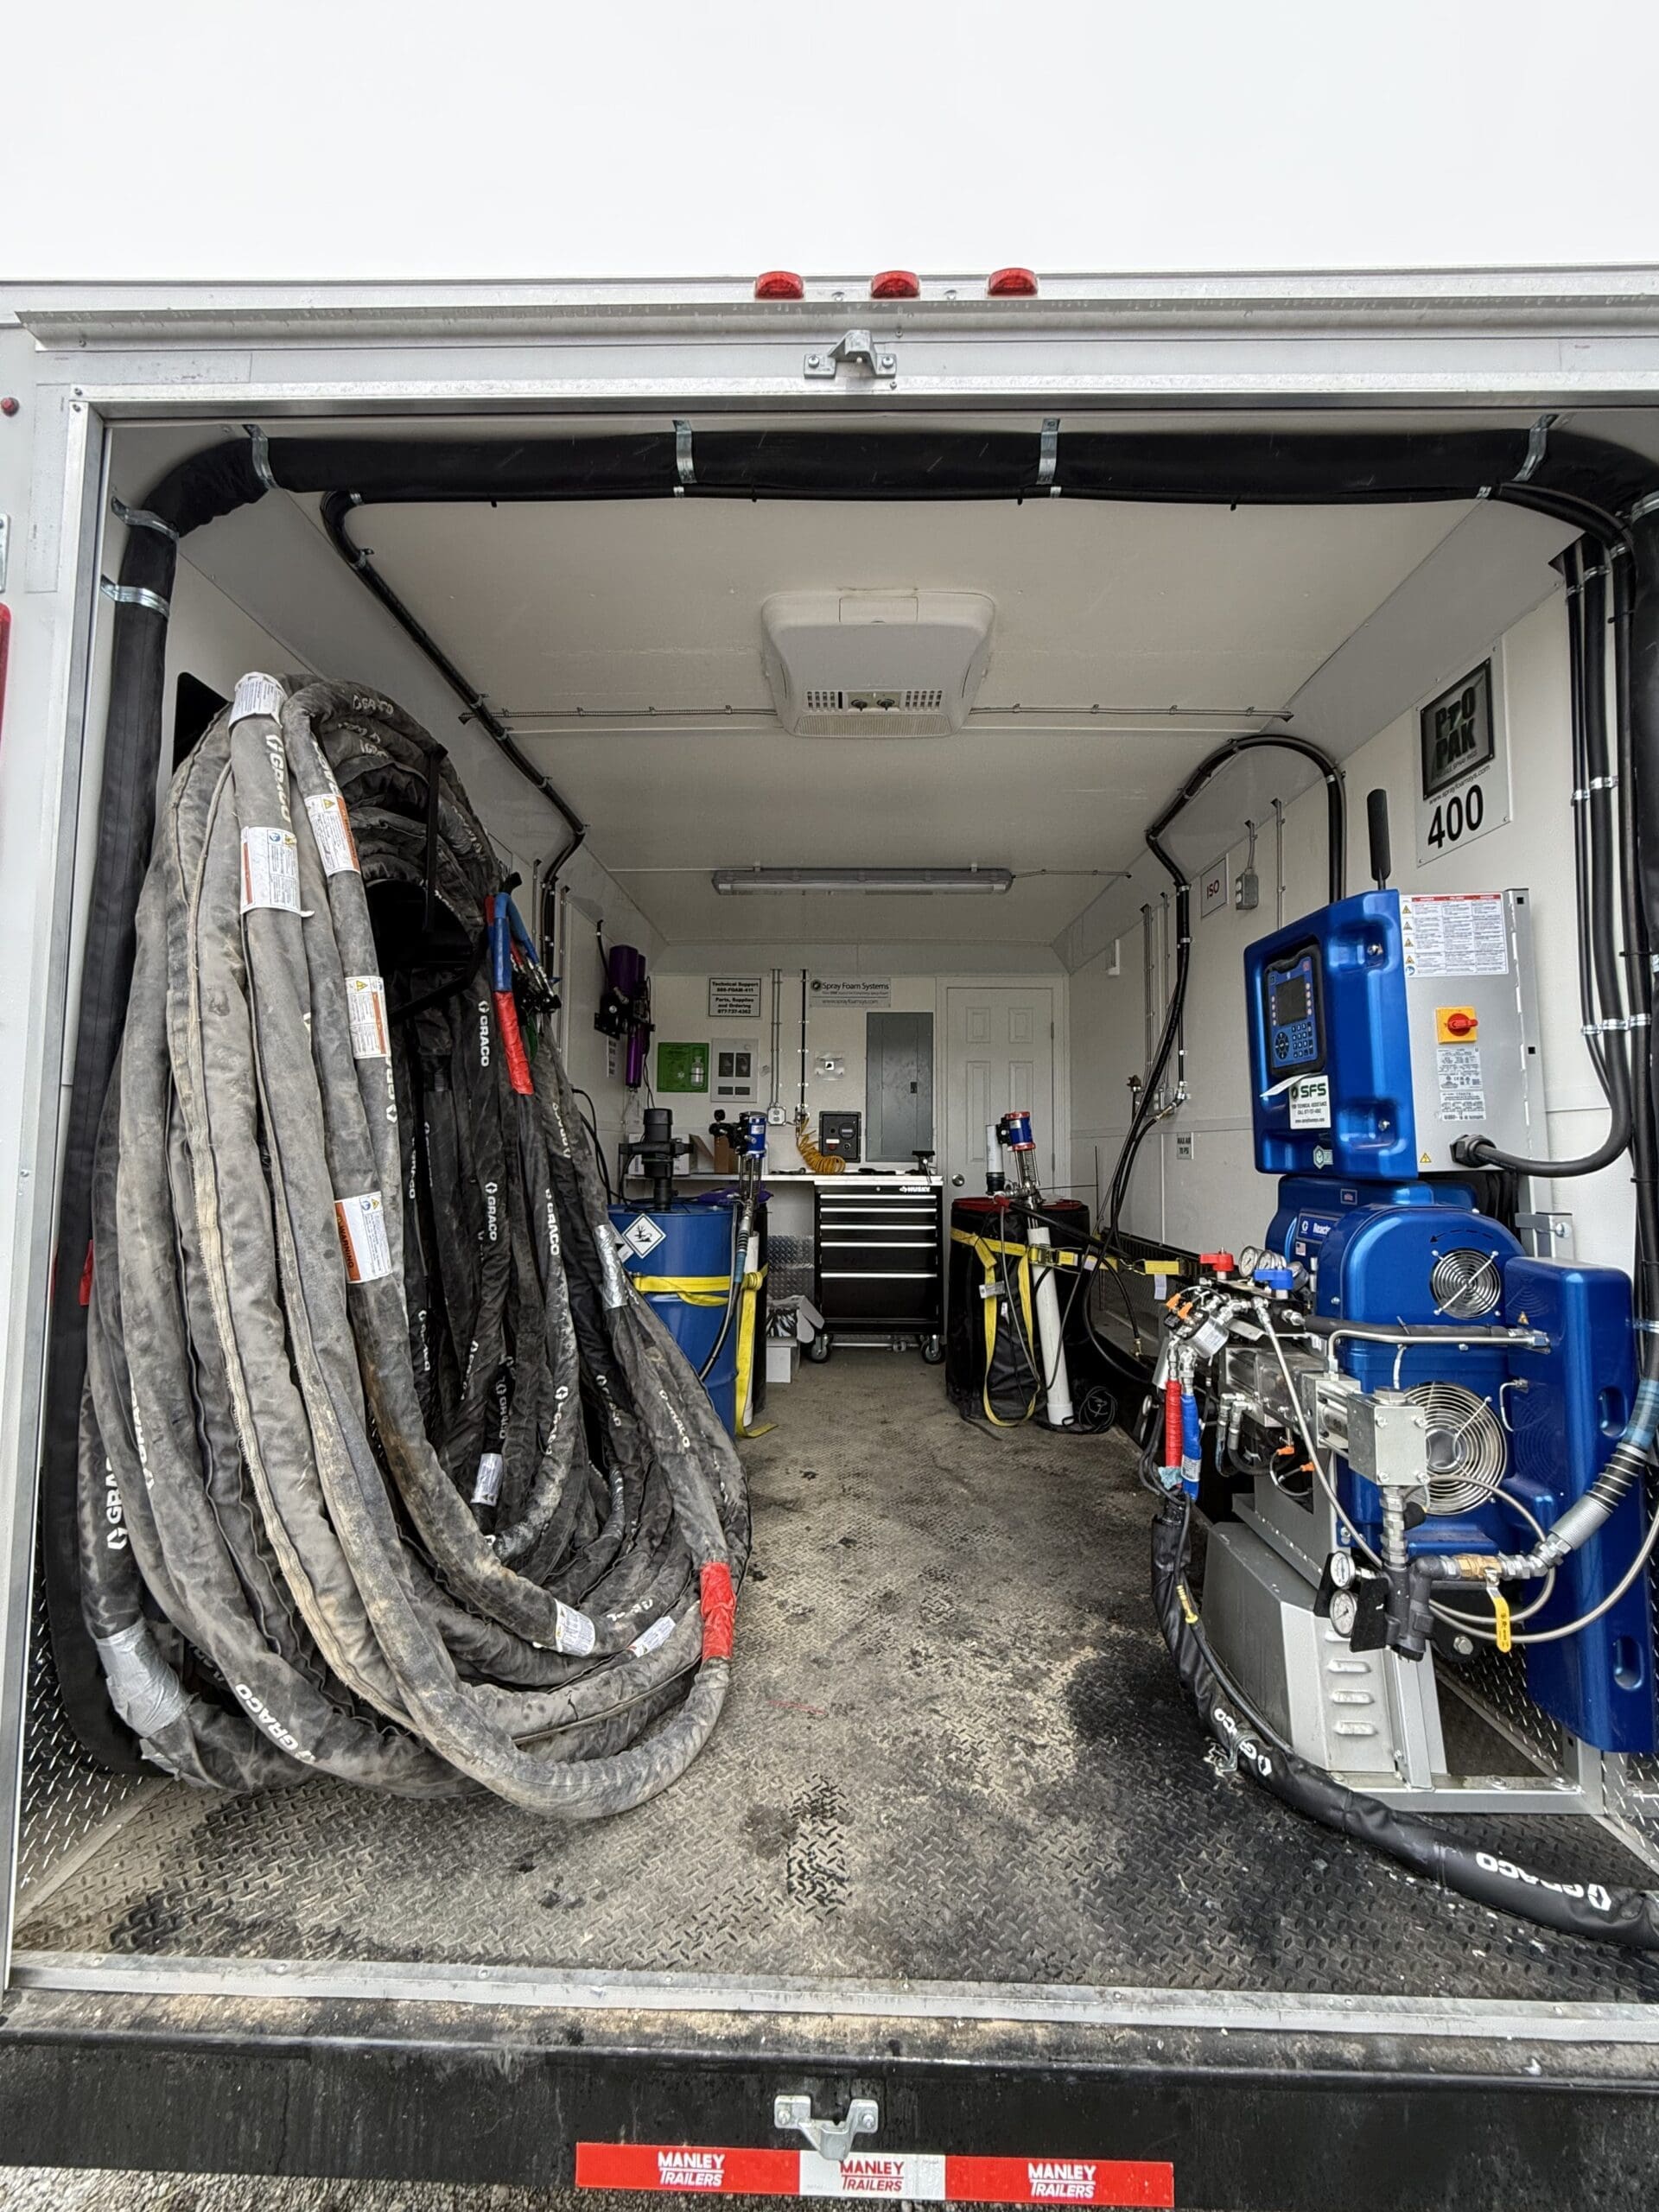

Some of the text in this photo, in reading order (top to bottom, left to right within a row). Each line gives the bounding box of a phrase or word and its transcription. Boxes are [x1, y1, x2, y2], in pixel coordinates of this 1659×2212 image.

[1435, 717, 1477, 771] PAK
[1427, 784, 1484, 849] 400
[1206, 879, 1220, 899] ISO
[822, 982, 841, 991] Spray
[861, 982, 889, 991] Systems
[480, 1015, 490, 1067] GRACO
[1300, 1083, 1327, 1098] SFS
[487, 1196, 498, 1242] GRACO
[547, 1202, 560, 1256] GRACO
[340, 1225, 353, 1268] WARNING
[235, 1683, 299, 1751] GRACO
[1476, 1851, 1585, 1898] GRACO
[658, 2151, 725, 2170] MANLEY
[840, 2160, 904, 2175] MANLEY
[659, 2170, 722, 2187] TRAILERS
[1027, 2162, 1096, 2181] MANLEY
[842, 2176, 903, 2191] TRAILERS
[1029, 2180, 1095, 2199] TRAILERS
